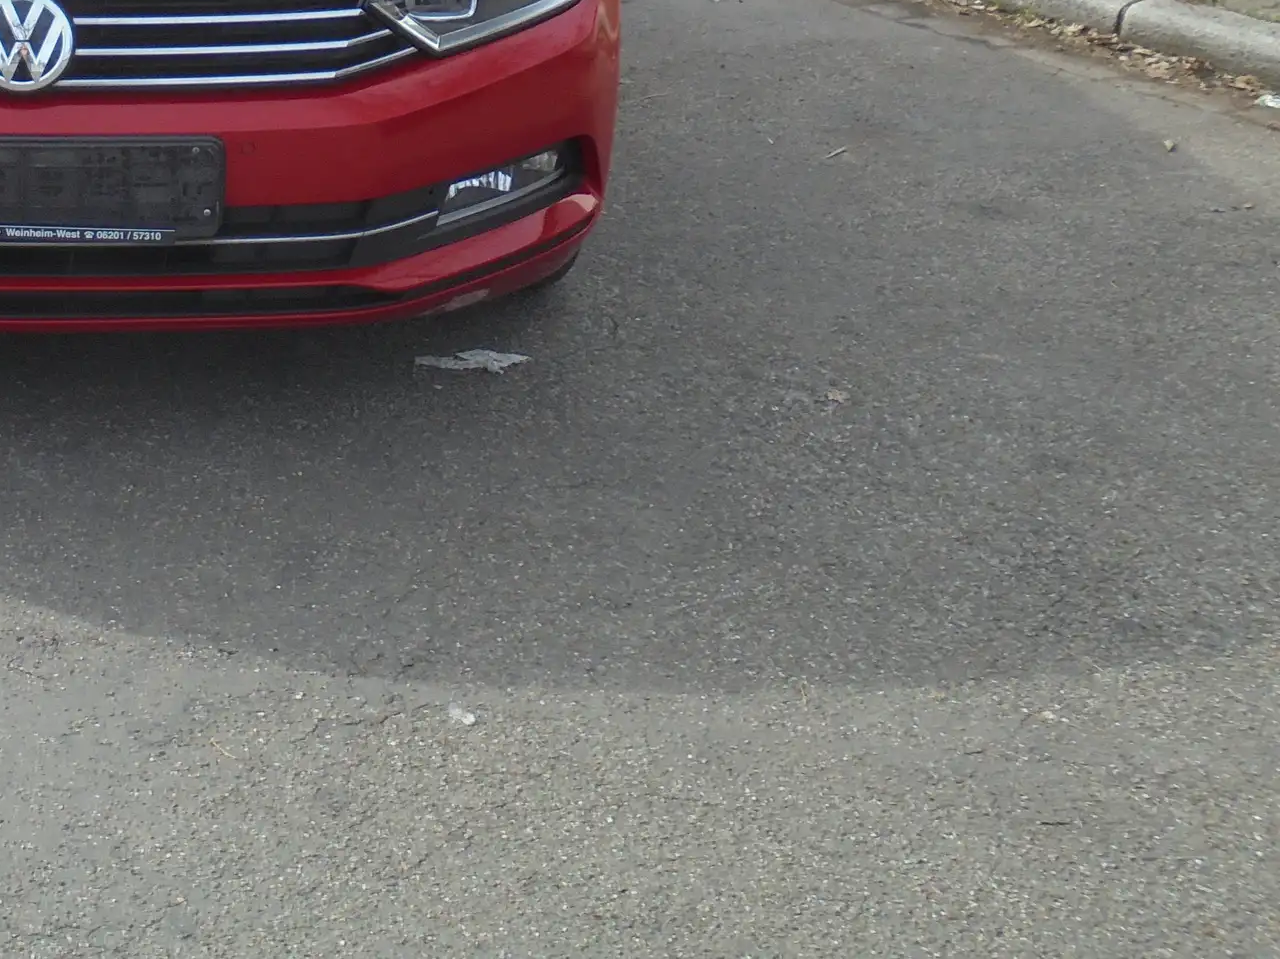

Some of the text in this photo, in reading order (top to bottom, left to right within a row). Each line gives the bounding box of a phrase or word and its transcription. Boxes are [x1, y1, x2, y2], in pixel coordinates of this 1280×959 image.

[5, 228, 80, 239] Weinheim-West
[96, 230, 124, 240] 06201
[132, 231, 162, 241] 57310
